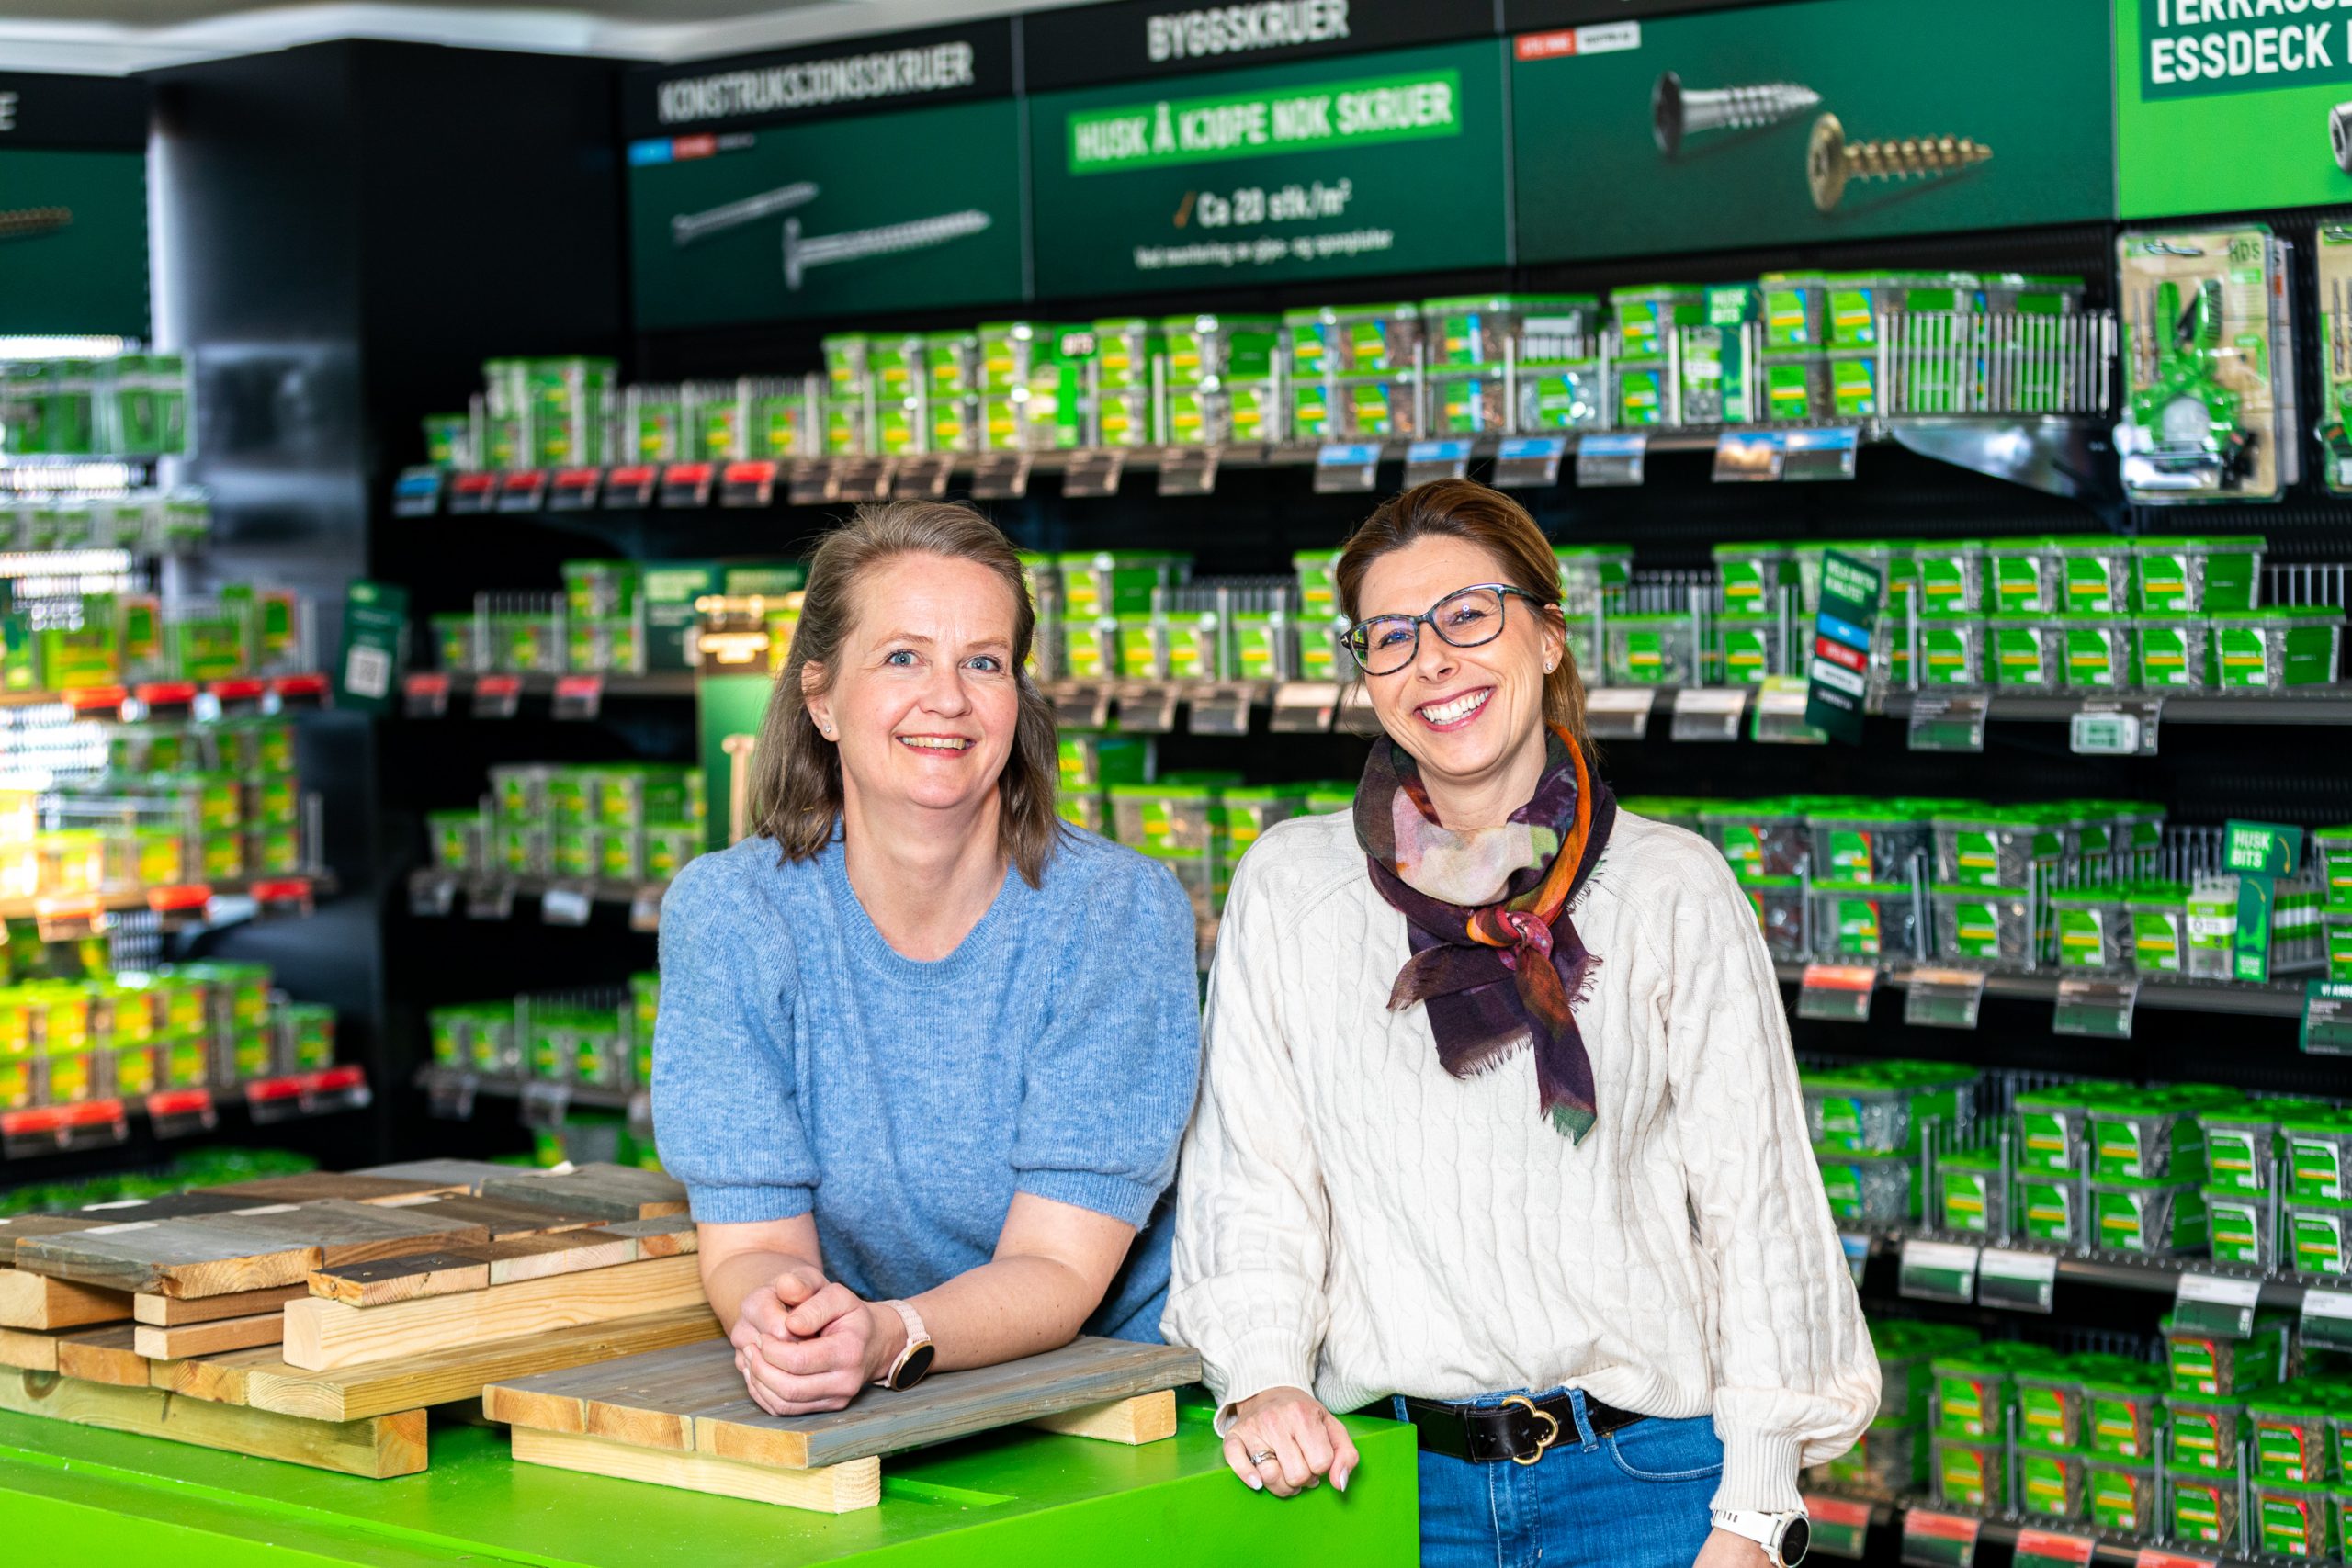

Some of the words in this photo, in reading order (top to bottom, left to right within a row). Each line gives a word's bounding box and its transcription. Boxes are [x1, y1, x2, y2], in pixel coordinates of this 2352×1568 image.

[1148, 0, 1351, 62] BYGGSKRUER
[2151, 21, 2334, 85] ESSDECK
[1074, 116, 1149, 162] HUSK
[1152, 101, 1177, 154] Å
[1272, 95, 1332, 141] NOK
[1335, 81, 1454, 134] SKRUER
[2232, 849, 2262, 867] BITS
[2233, 829, 2271, 851] HUSK
